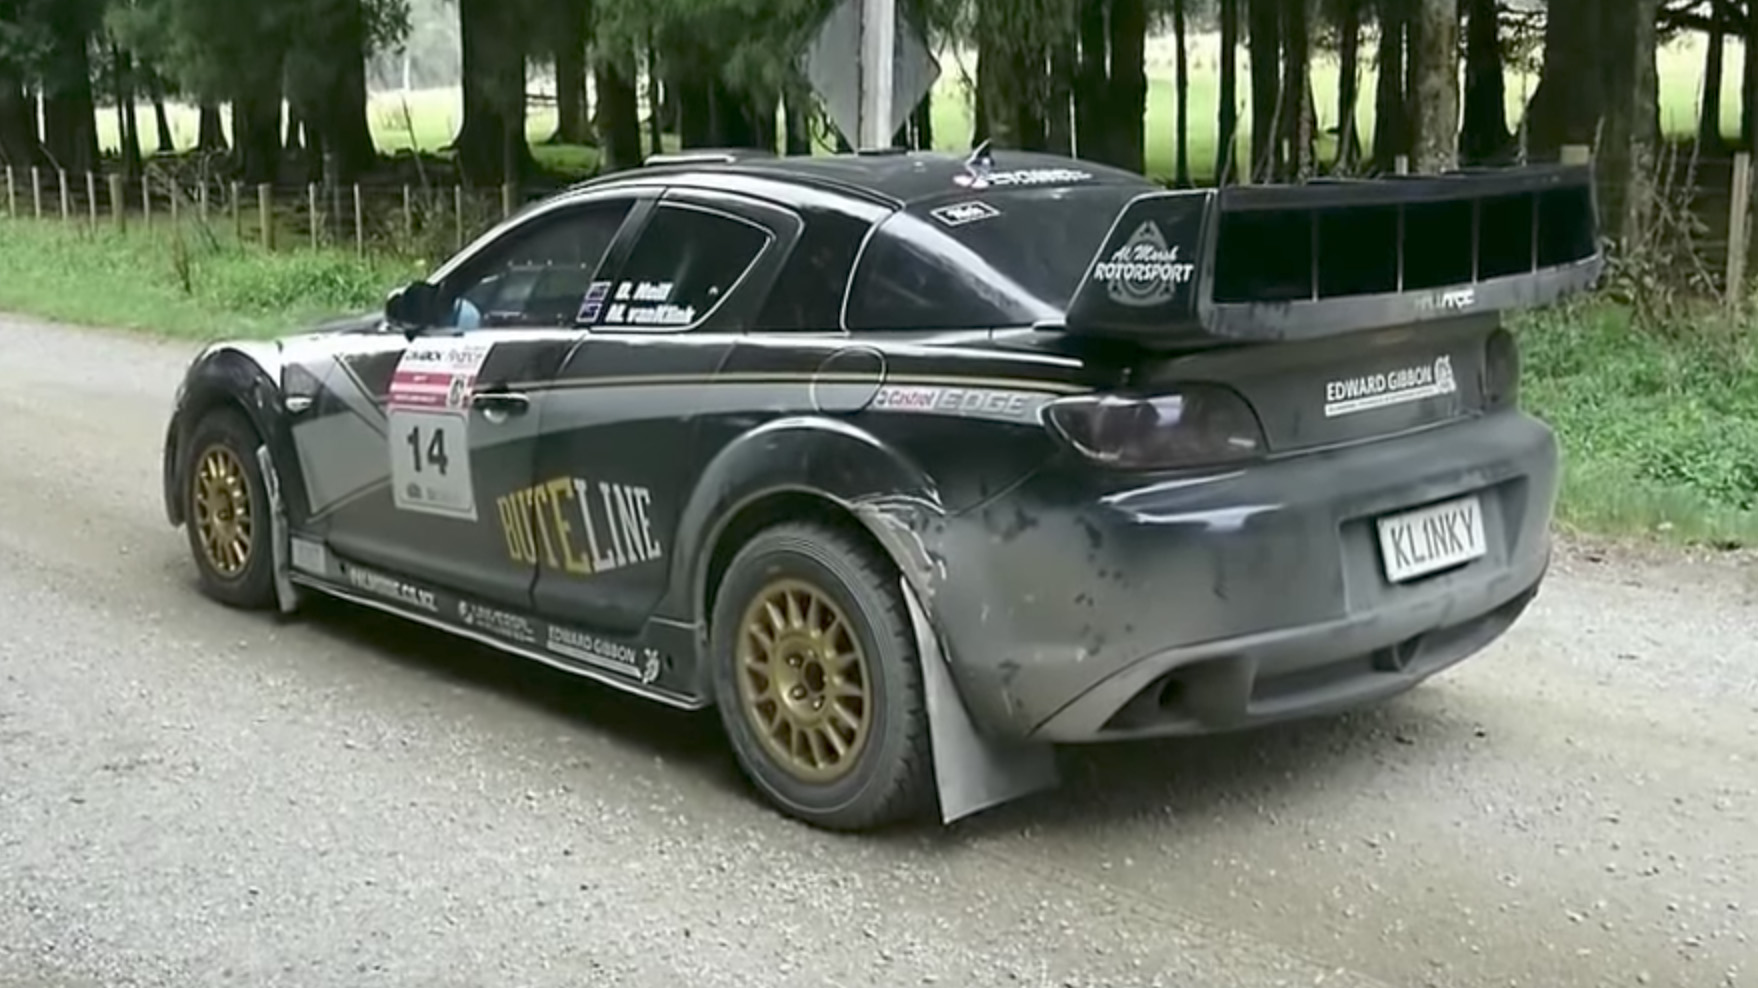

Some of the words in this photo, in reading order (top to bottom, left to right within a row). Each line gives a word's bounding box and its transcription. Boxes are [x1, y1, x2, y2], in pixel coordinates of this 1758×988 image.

[1093, 262, 1195, 283] ROTORSPORT
[1326, 373, 1386, 402] EDWARD
[1387, 364, 1433, 391] GIBBON
[940, 388, 1024, 417] EDGE
[406, 425, 449, 477] 14
